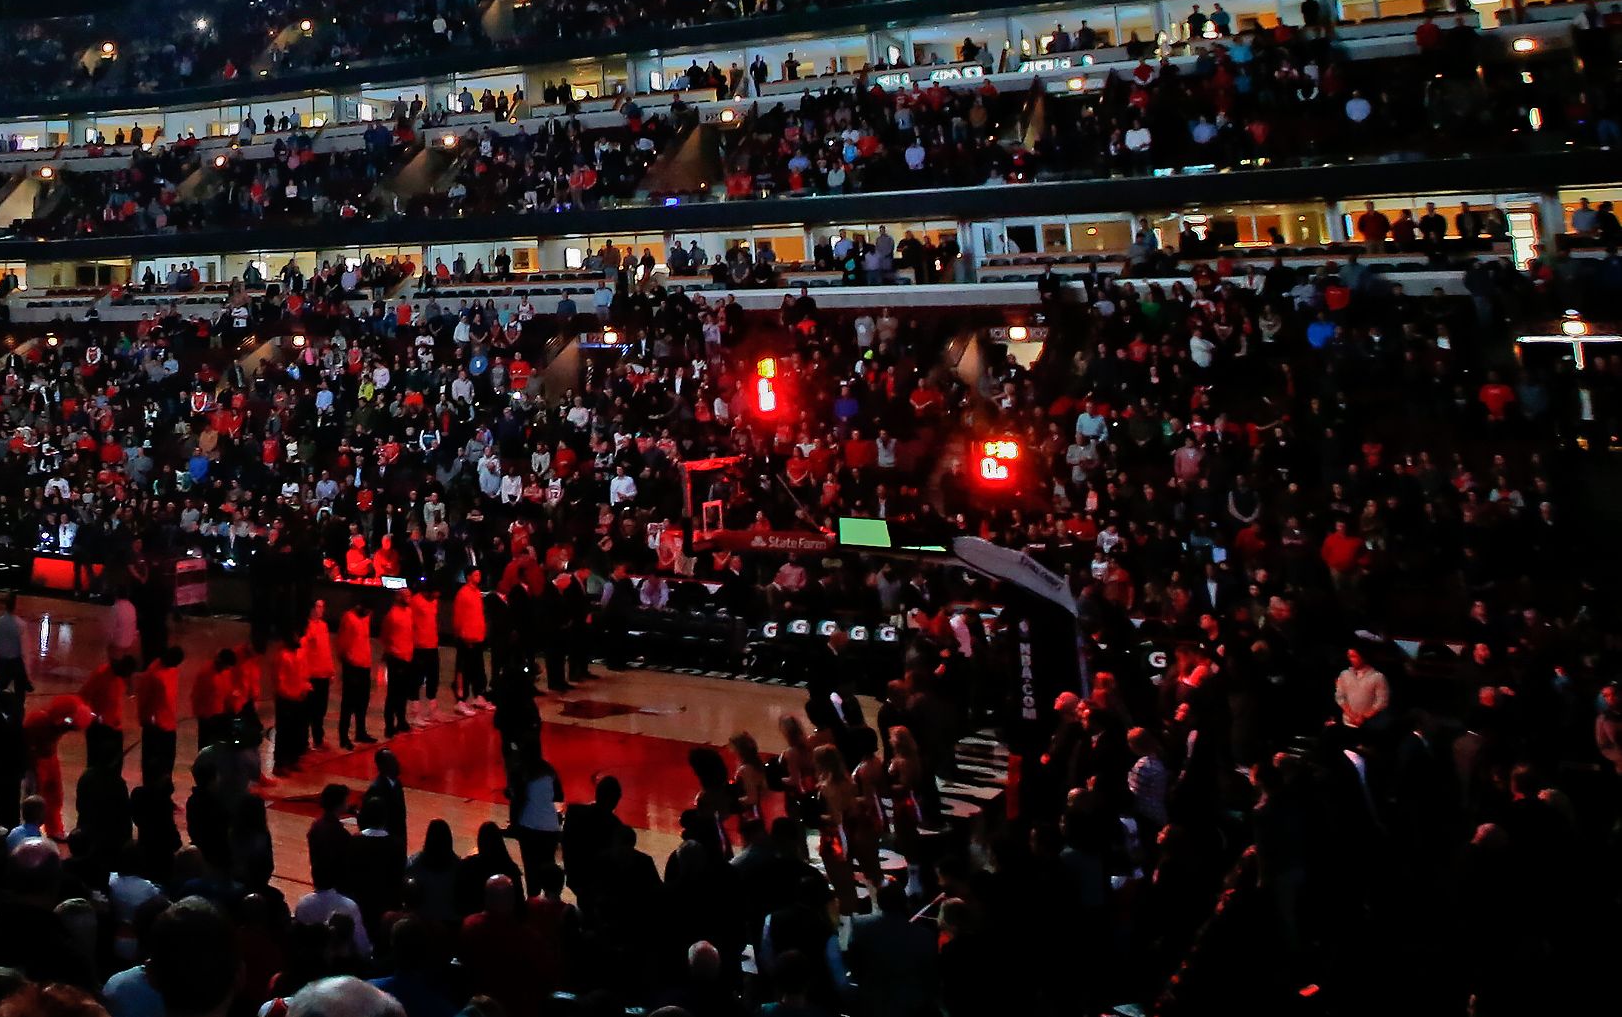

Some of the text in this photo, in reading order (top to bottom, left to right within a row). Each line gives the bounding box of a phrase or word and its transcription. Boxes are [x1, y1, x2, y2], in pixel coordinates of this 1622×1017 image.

[768, 536, 827, 549] State Farm
[1148, 651, 1167, 668] G
